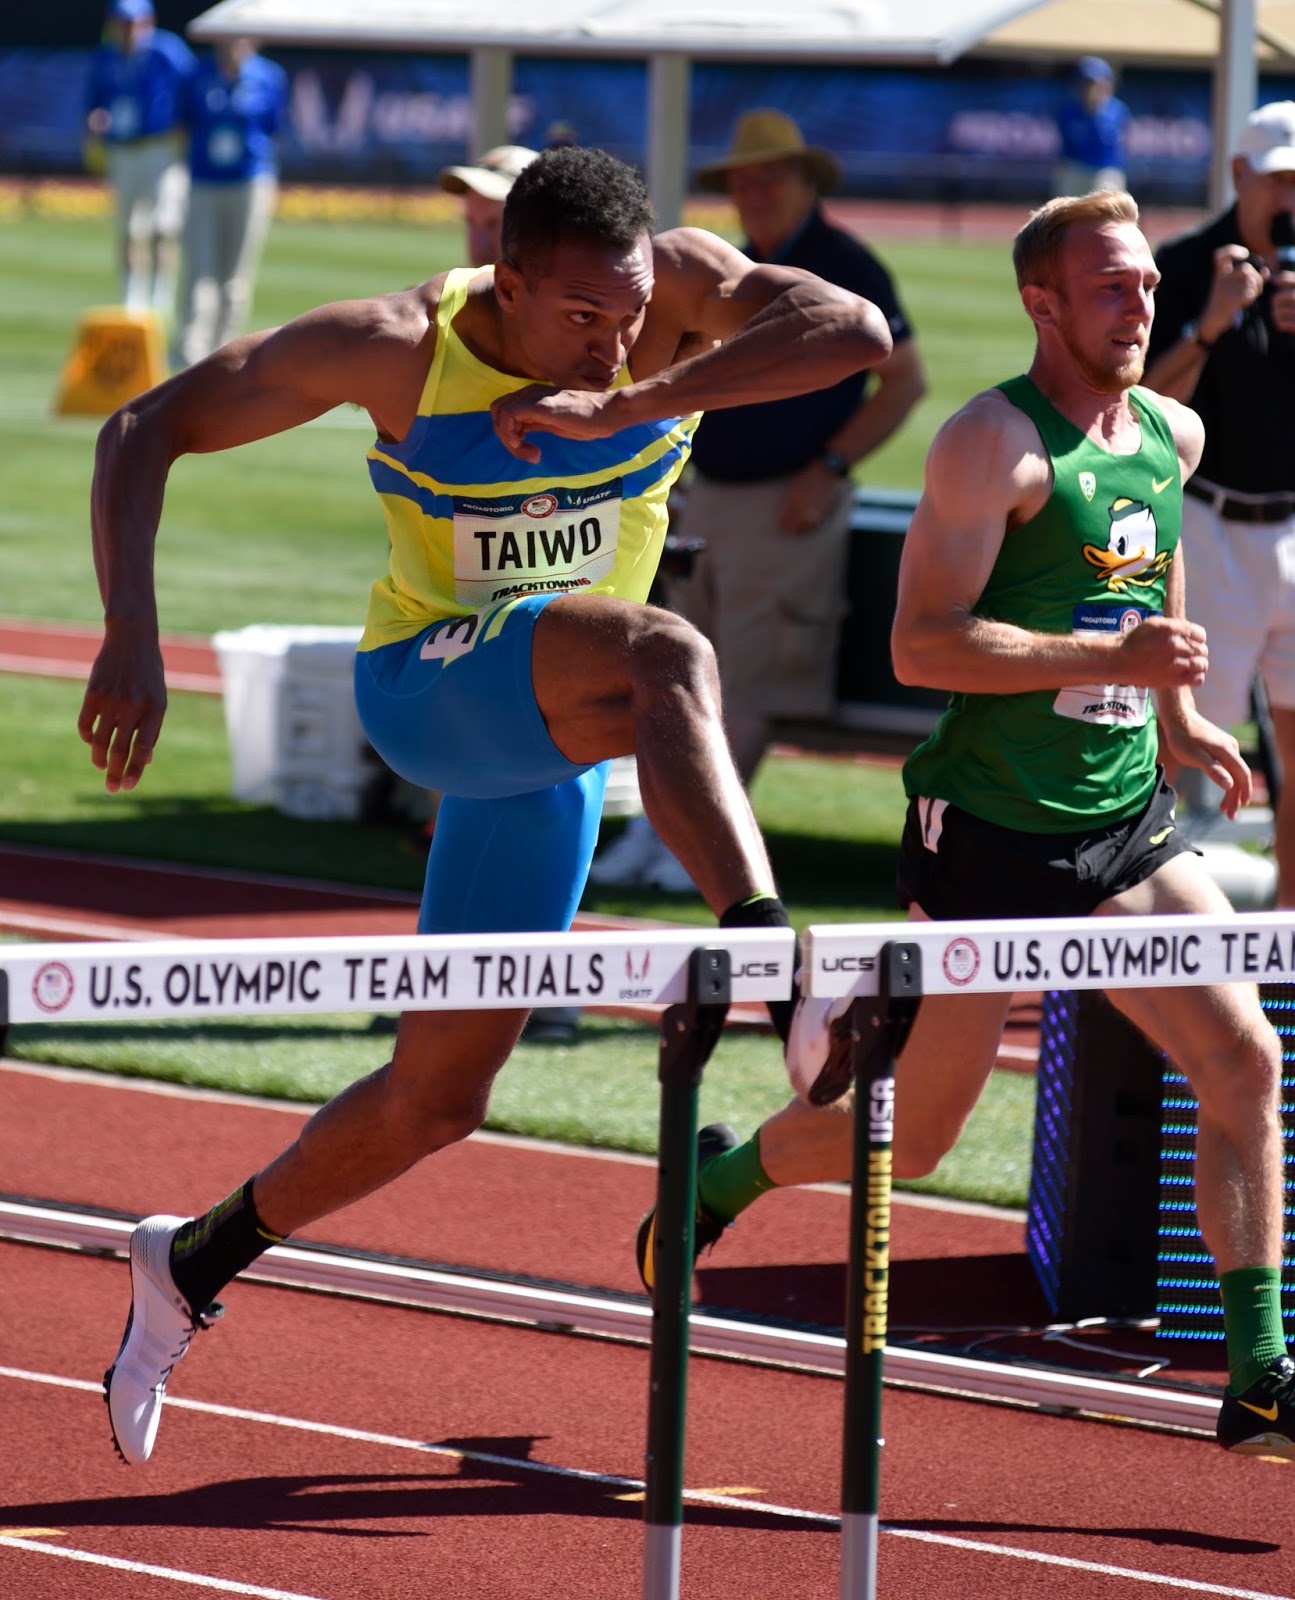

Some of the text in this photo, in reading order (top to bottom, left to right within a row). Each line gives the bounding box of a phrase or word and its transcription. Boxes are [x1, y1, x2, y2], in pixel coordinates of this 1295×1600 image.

[462, 503, 514, 513] #ROADTORIO
[582, 490, 612, 504] USATF
[474, 517, 602, 570] TAIWO
[821, 956, 876, 972] UCS
[992, 940, 1050, 981] U.S.
[1060, 933, 1202, 979] OLYMPIC
[1220, 930, 1295, 975] TEA
[89, 965, 152, 1009] U.S.
[164, 959, 321, 1007] OLYMPIC
[344, 955, 450, 1001] TEAM
[473, 952, 605, 999] TRIALS
[619, 988, 653, 999] USATF
[862, 1077, 895, 1354] TRACKTOWN USA
